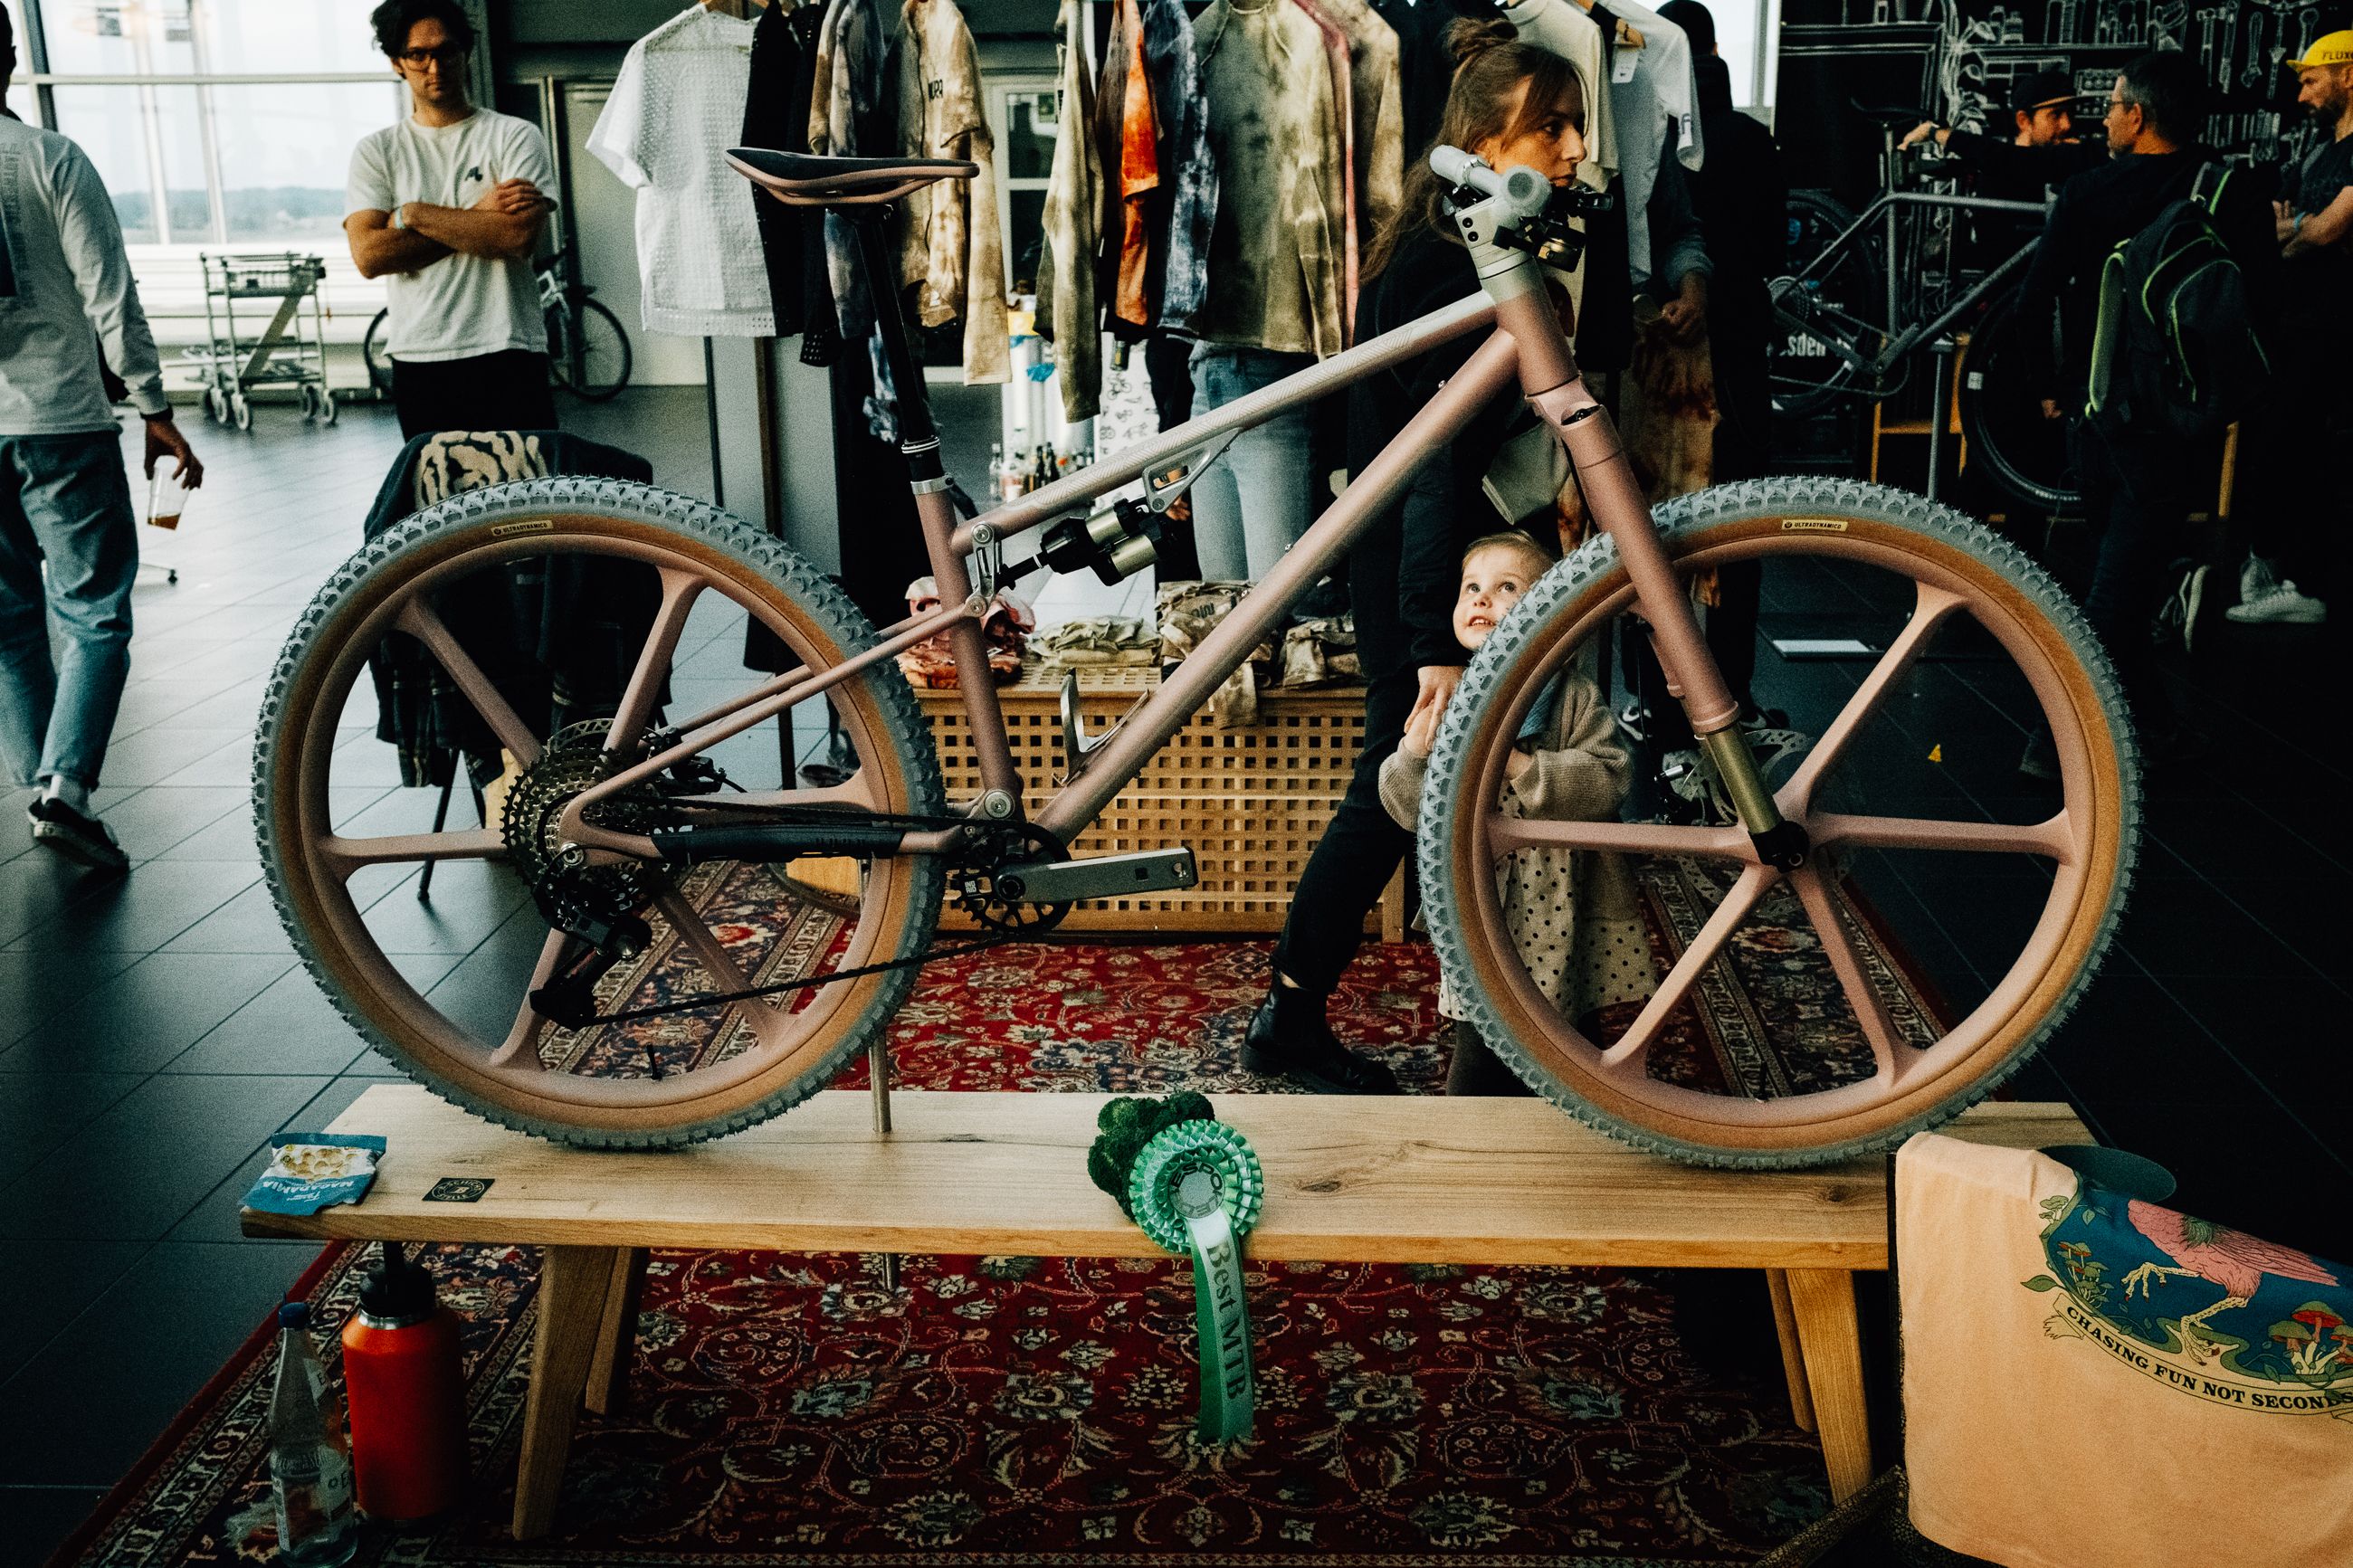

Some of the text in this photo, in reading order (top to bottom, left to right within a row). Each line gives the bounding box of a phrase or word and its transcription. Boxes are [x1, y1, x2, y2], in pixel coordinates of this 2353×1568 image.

[1786, 332, 1827, 356] sden
[502, 523, 548, 532] ULTRADYNAMICO
[262, 1181, 355, 1194] MACADAMIA
[1205, 1240, 1246, 1401] Best MTB
[2067, 1307, 2149, 1370] CHASING
[2154, 1364, 2198, 1391] FUN
[2203, 1381, 2245, 1403] NOT
